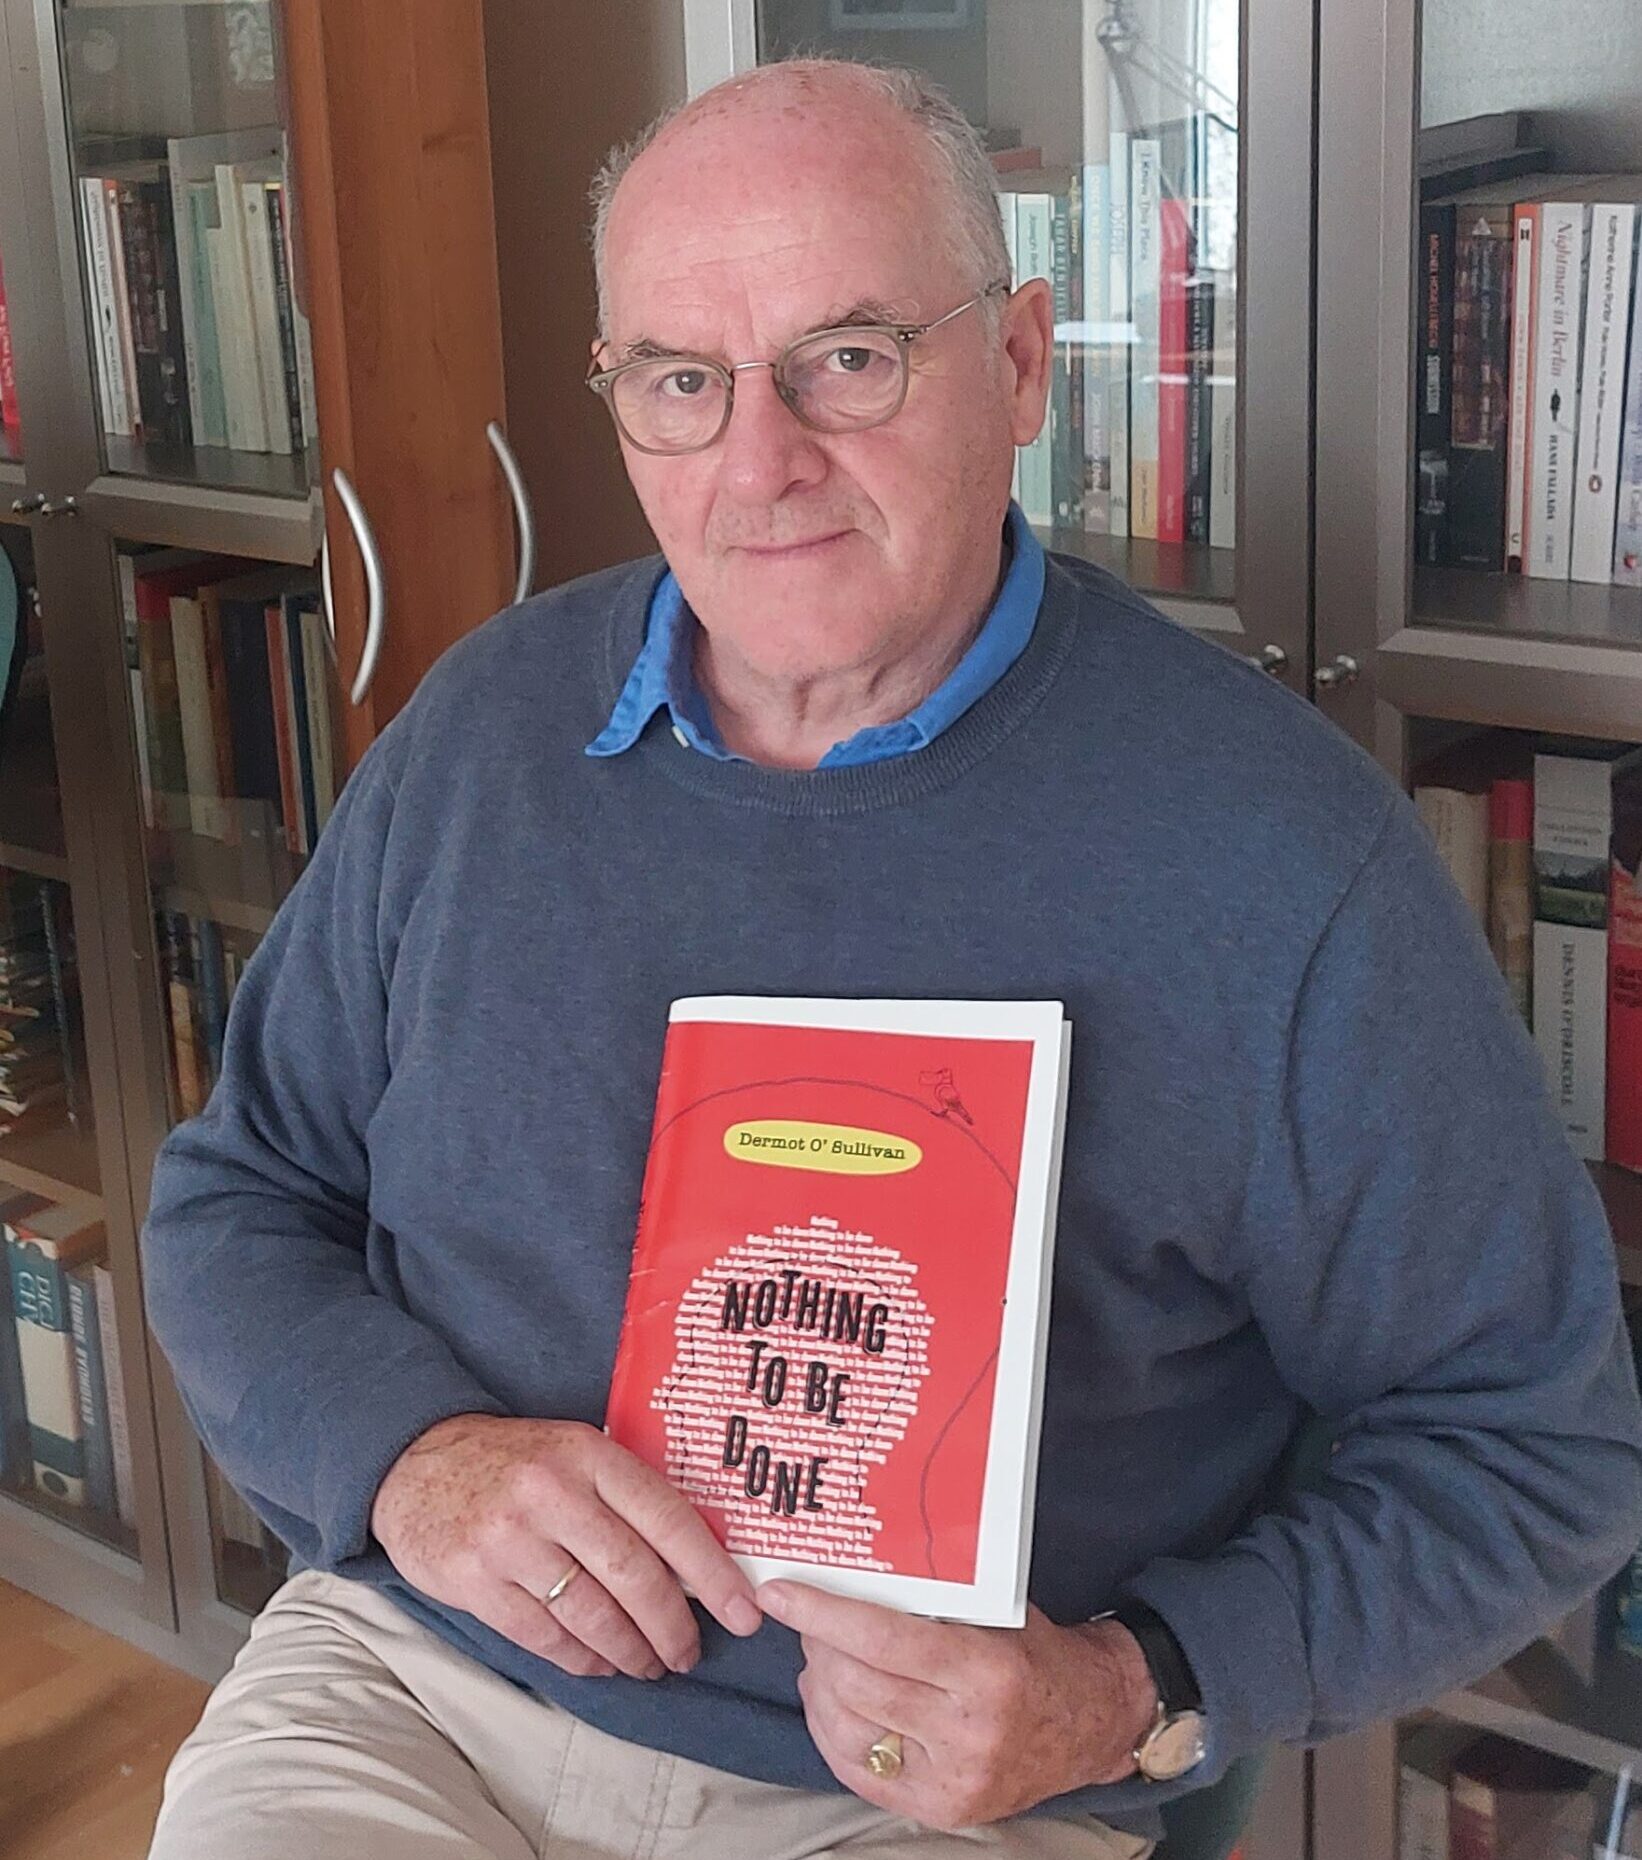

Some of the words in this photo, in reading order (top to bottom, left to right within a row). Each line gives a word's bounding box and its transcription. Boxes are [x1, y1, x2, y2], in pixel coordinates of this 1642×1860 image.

[1139, 159, 1150, 196] Know
[1139, 199, 1150, 225] This
[1551, 220, 1573, 306] Nightmare
[1604, 265, 1615, 291] Anne
[1552, 309, 1566, 325] in
[1550, 330, 1569, 378] Berlin
[1562, 942, 1576, 1006] DENNIS
[739, 1132, 805, 1151] Dermot
[810, 1138, 828, 1152] O'
[831, 1140, 906, 1160] Sullivan
[720, 1269, 889, 1355] NOTHING
[745, 1340, 788, 1408] TO
[803, 1360, 851, 1427] BE
[722, 1415, 829, 1517] DONE
